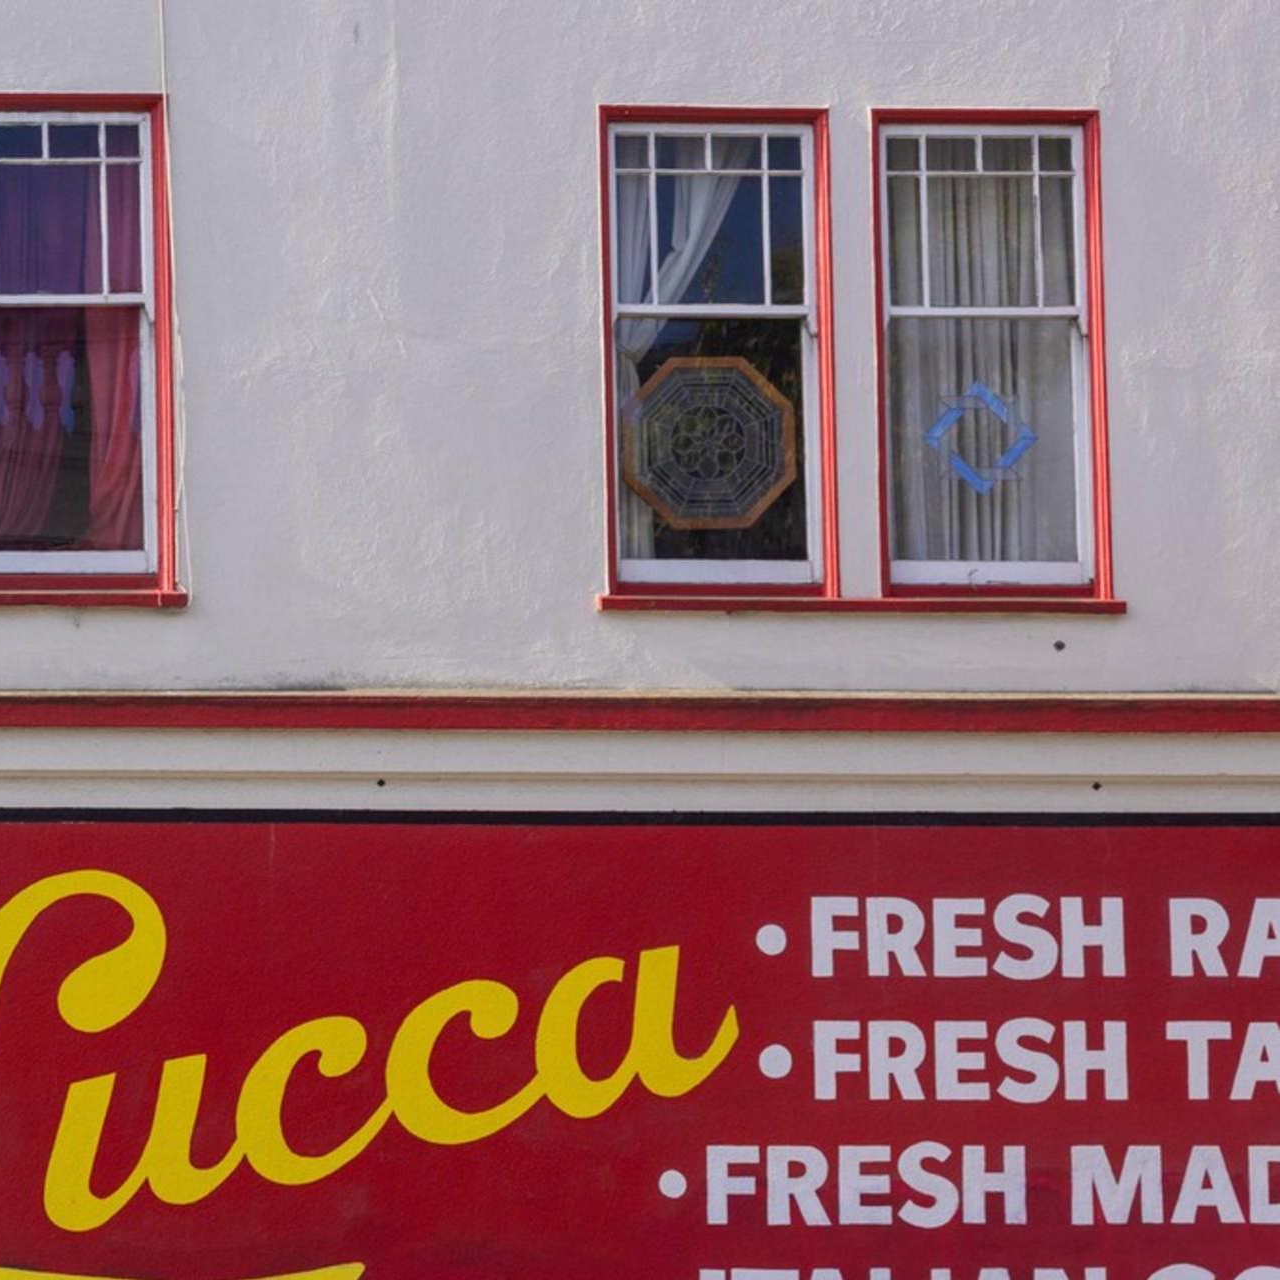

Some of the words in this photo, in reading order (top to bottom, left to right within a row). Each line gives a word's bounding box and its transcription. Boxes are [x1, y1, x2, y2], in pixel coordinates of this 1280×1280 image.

[810, 893, 1125, 980] FRESH
[813, 1016, 1128, 1104] FRESH
[705, 1140, 1027, 1229] FRESH
